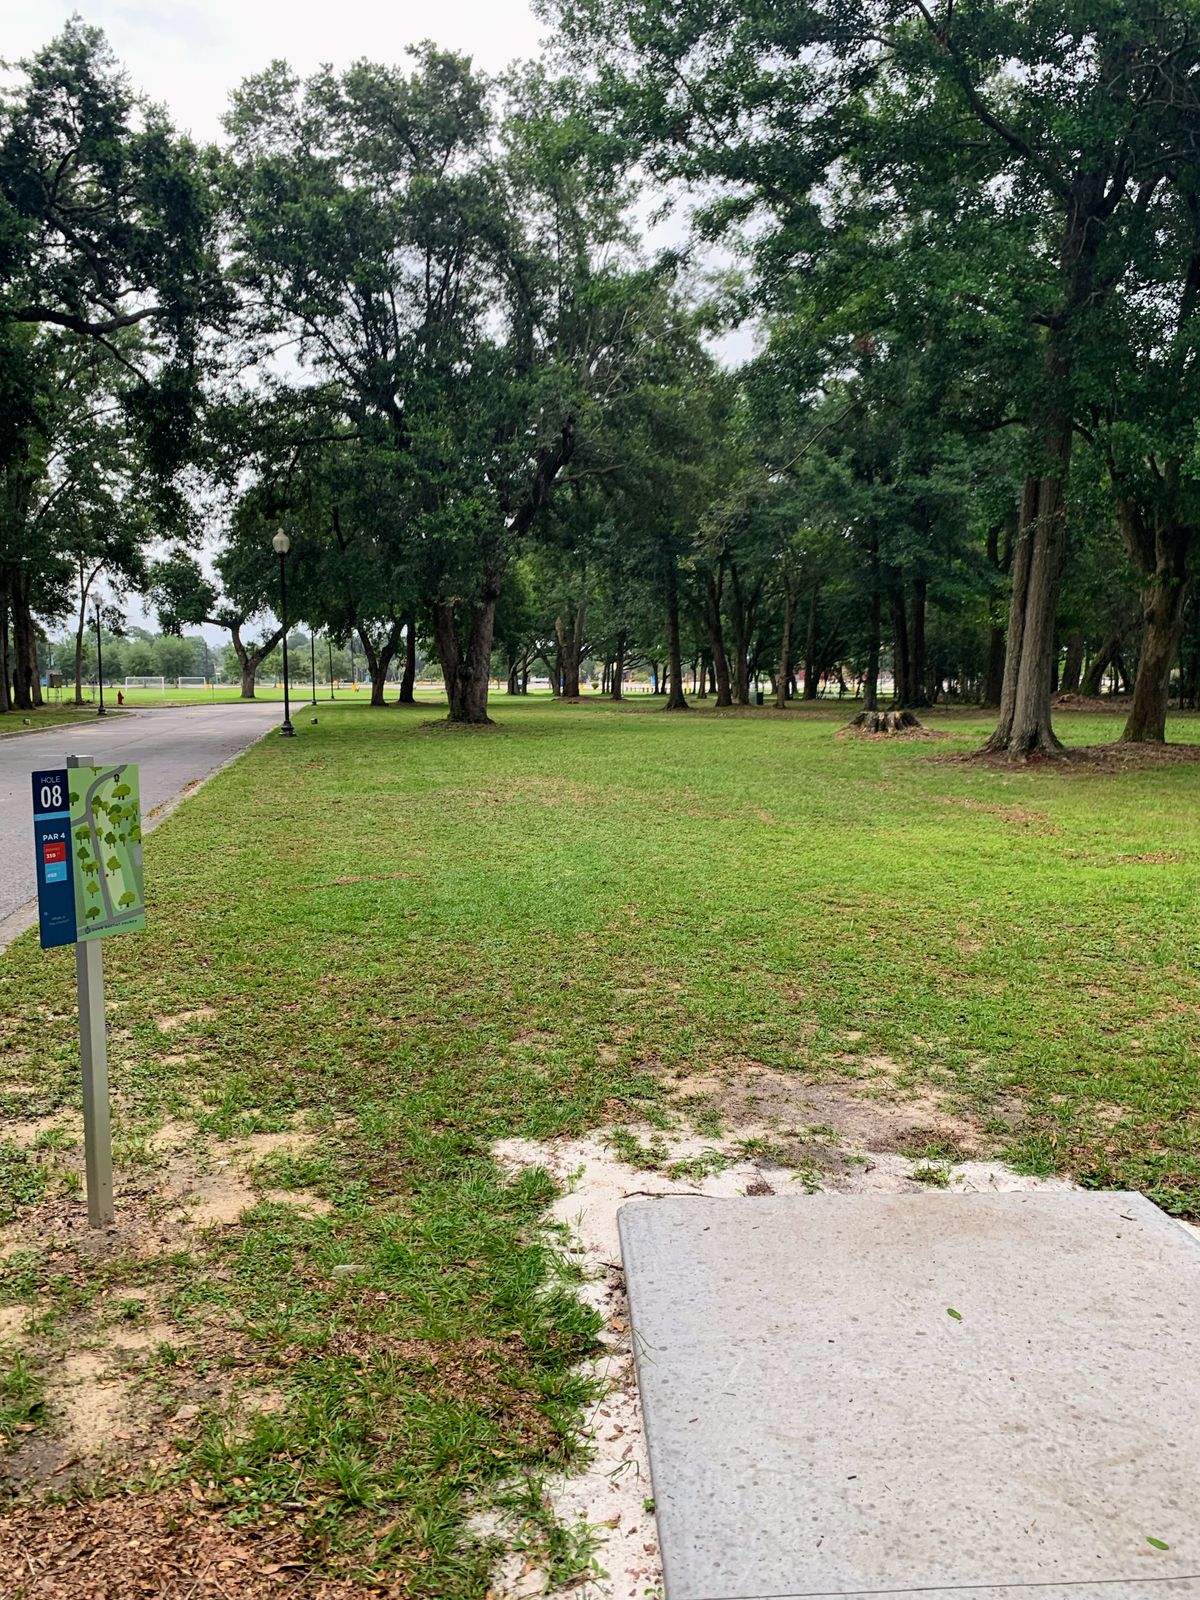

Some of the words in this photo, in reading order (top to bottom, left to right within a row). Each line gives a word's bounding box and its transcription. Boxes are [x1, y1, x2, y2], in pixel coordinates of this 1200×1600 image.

[40, 775, 61, 784] HOLE
[40, 785, 62, 808] 08
[42, 833, 59, 841] PAR
